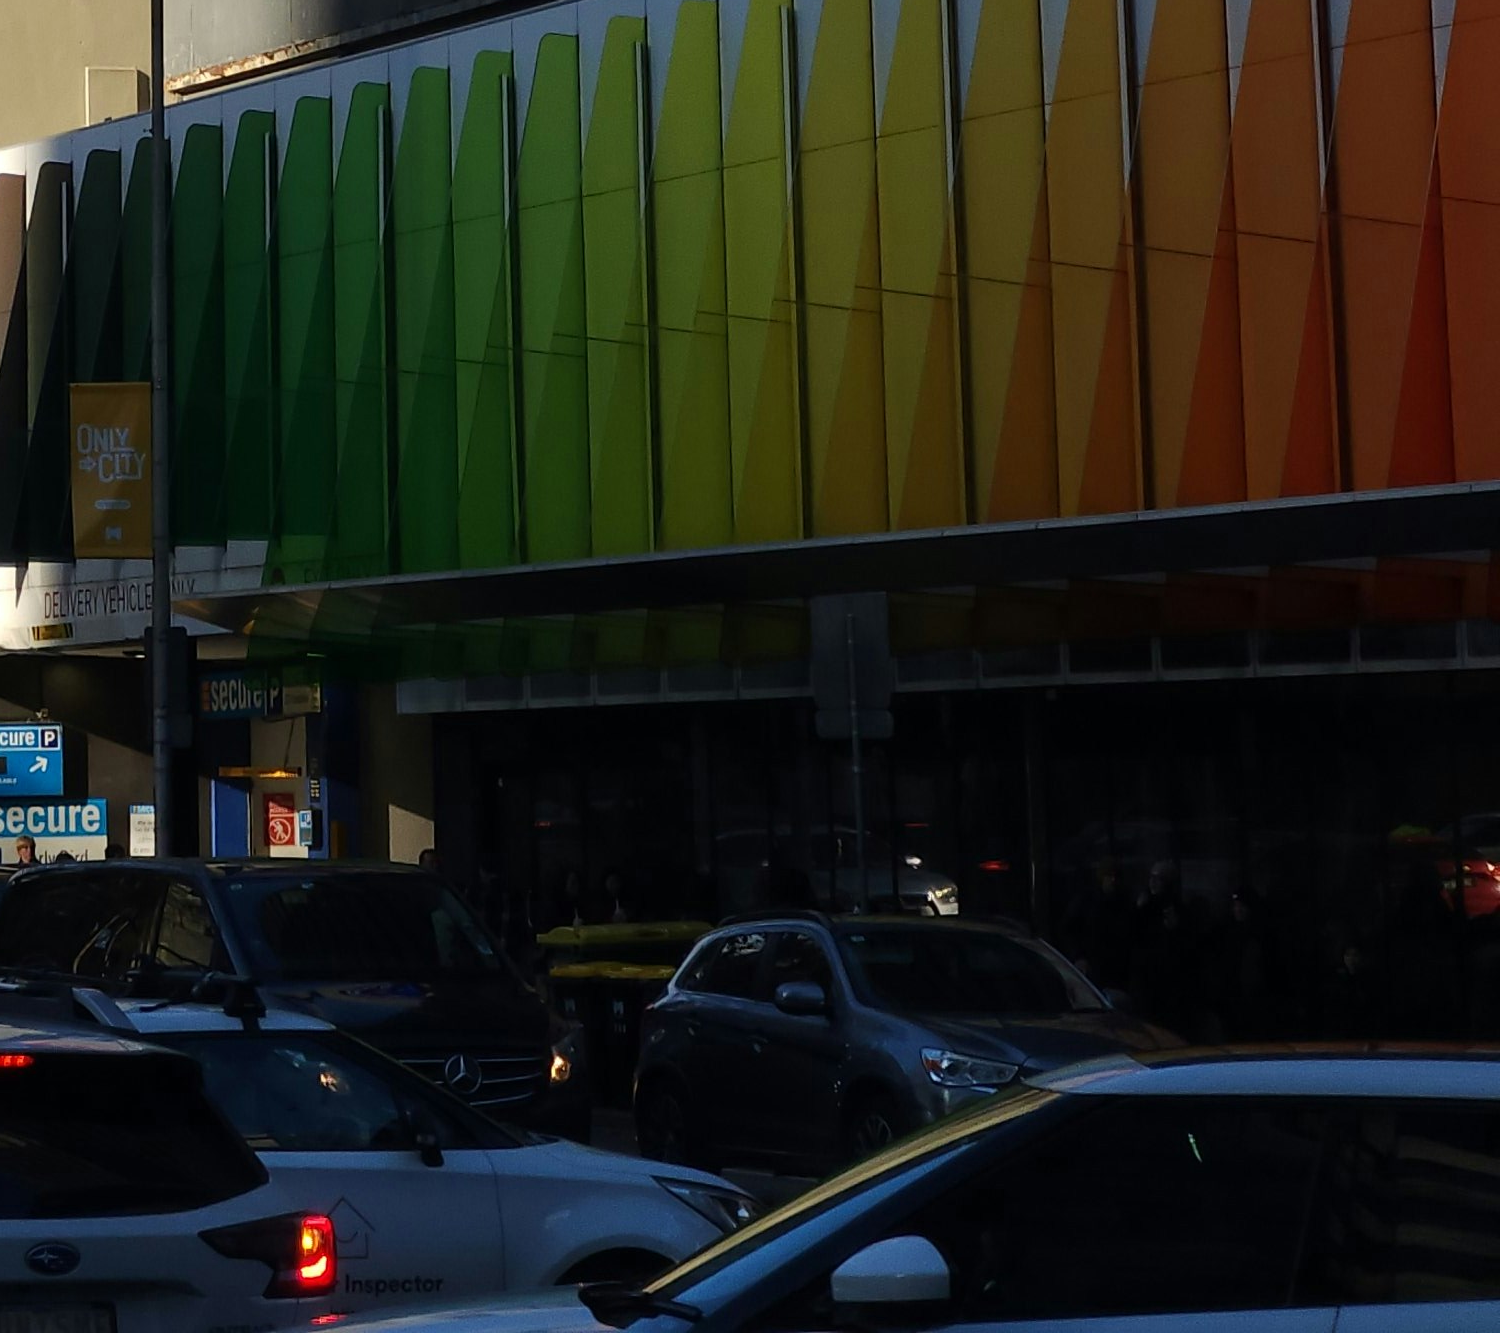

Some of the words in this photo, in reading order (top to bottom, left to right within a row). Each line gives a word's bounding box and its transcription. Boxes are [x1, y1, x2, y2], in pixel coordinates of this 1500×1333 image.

[98, 452, 146, 483] CITY
[44, 588, 99, 620] DELIVERY
[211, 678, 262, 712] secure
[43, 731, 56, 746] P
[345, 1273, 444, 1297] Inspector
